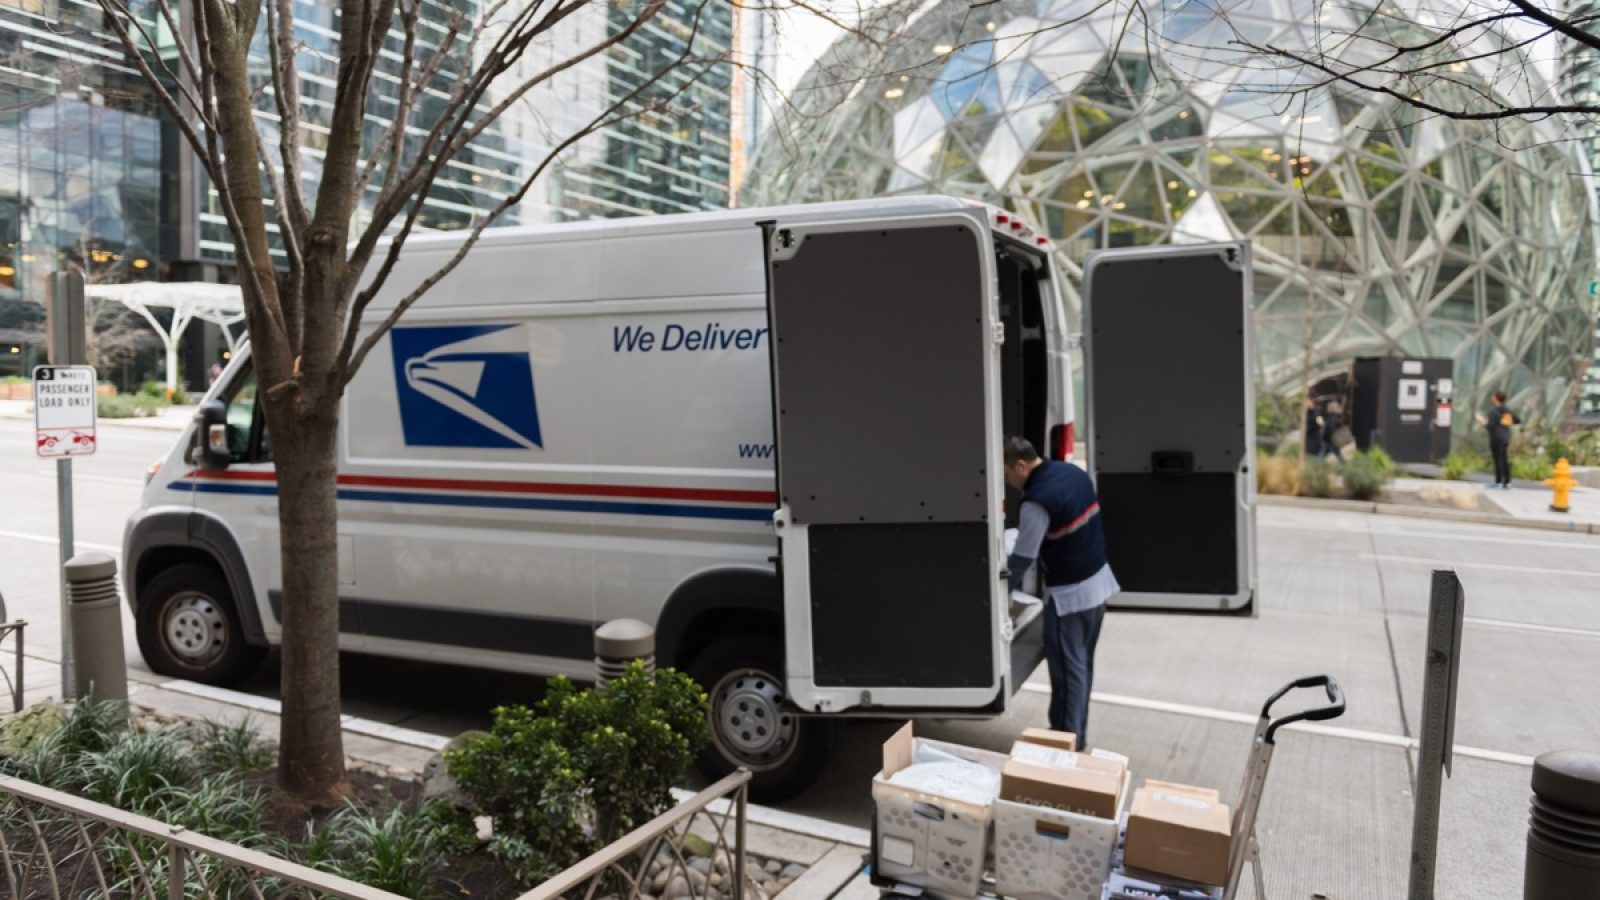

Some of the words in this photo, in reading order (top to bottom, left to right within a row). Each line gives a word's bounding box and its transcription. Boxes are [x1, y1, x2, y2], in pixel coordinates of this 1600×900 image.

[613, 325, 655, 352] We
[660, 323, 768, 351] Deliver
[42, 368, 50, 380] 3
[40, 384, 89, 394] PASSENGER
[40, 398, 63, 408] LOAD
[68, 397, 90, 408] ONLY
